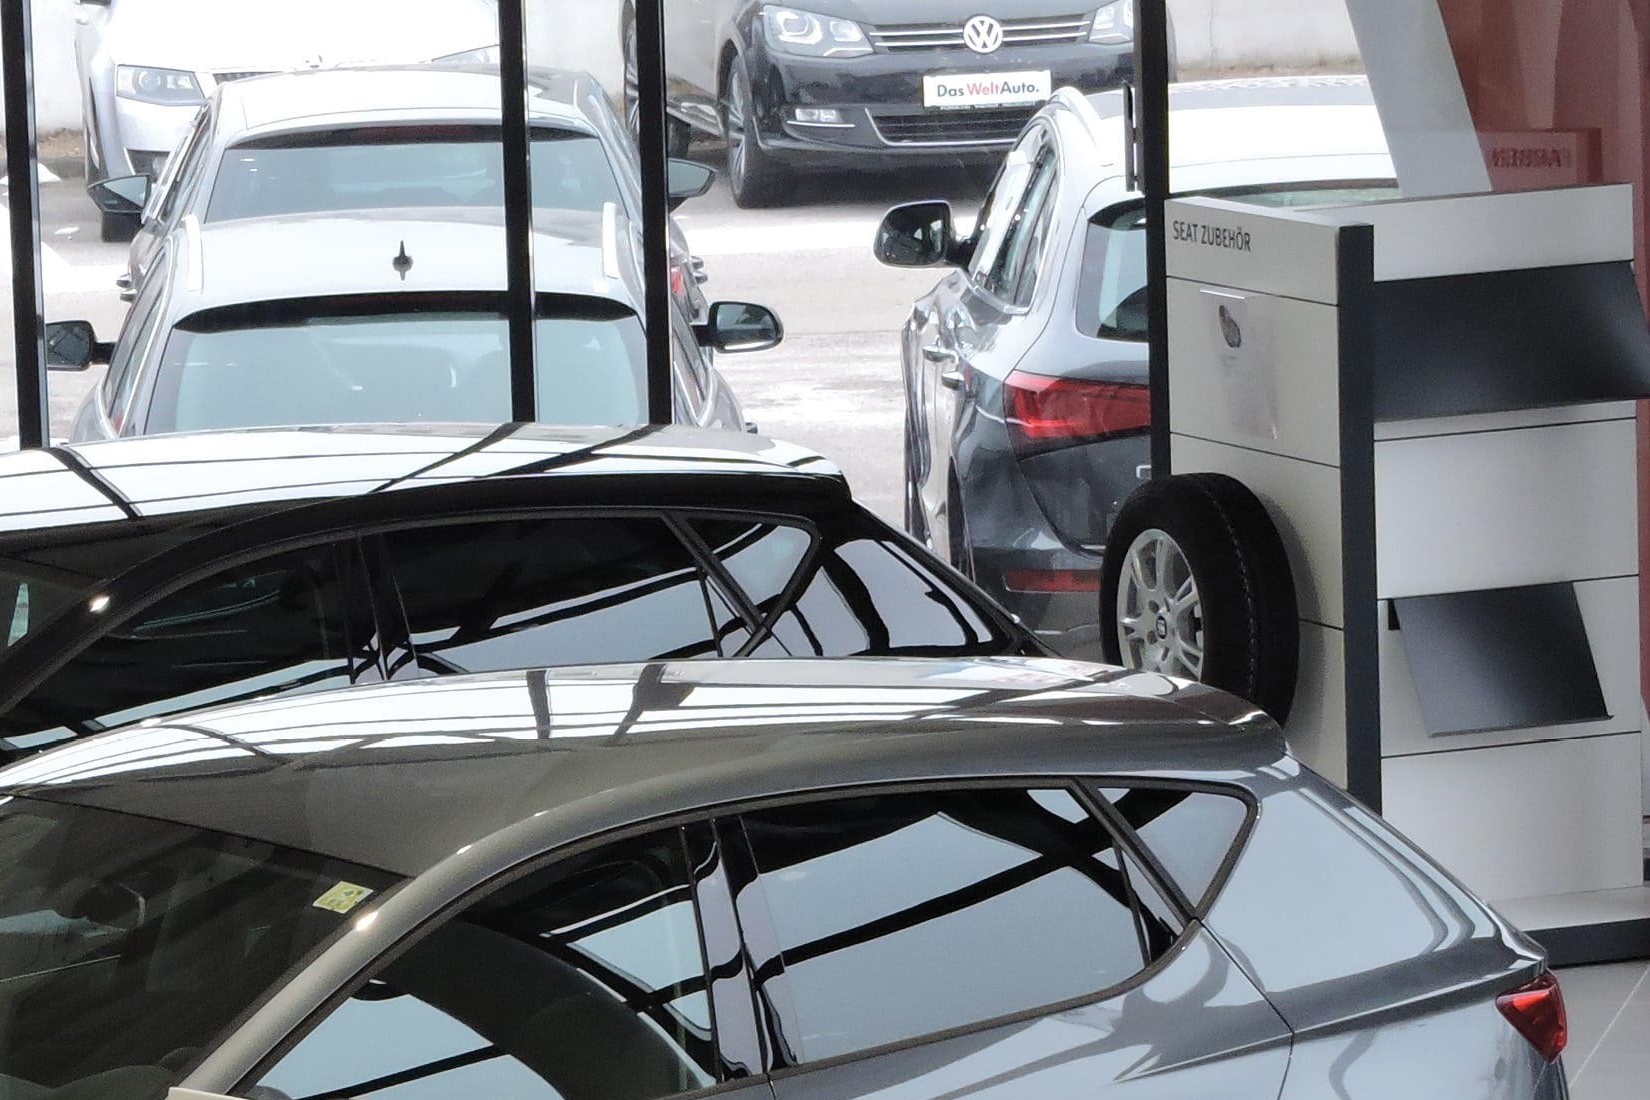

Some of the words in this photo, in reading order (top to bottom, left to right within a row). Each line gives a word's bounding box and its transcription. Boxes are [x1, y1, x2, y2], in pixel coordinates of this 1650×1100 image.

[937, 84, 965, 97] Das
[967, 81, 1040, 96] WeltAuto.
[1172, 220, 1199, 242] SEAT
[1201, 225, 1252, 252] ZUBEHÖR
